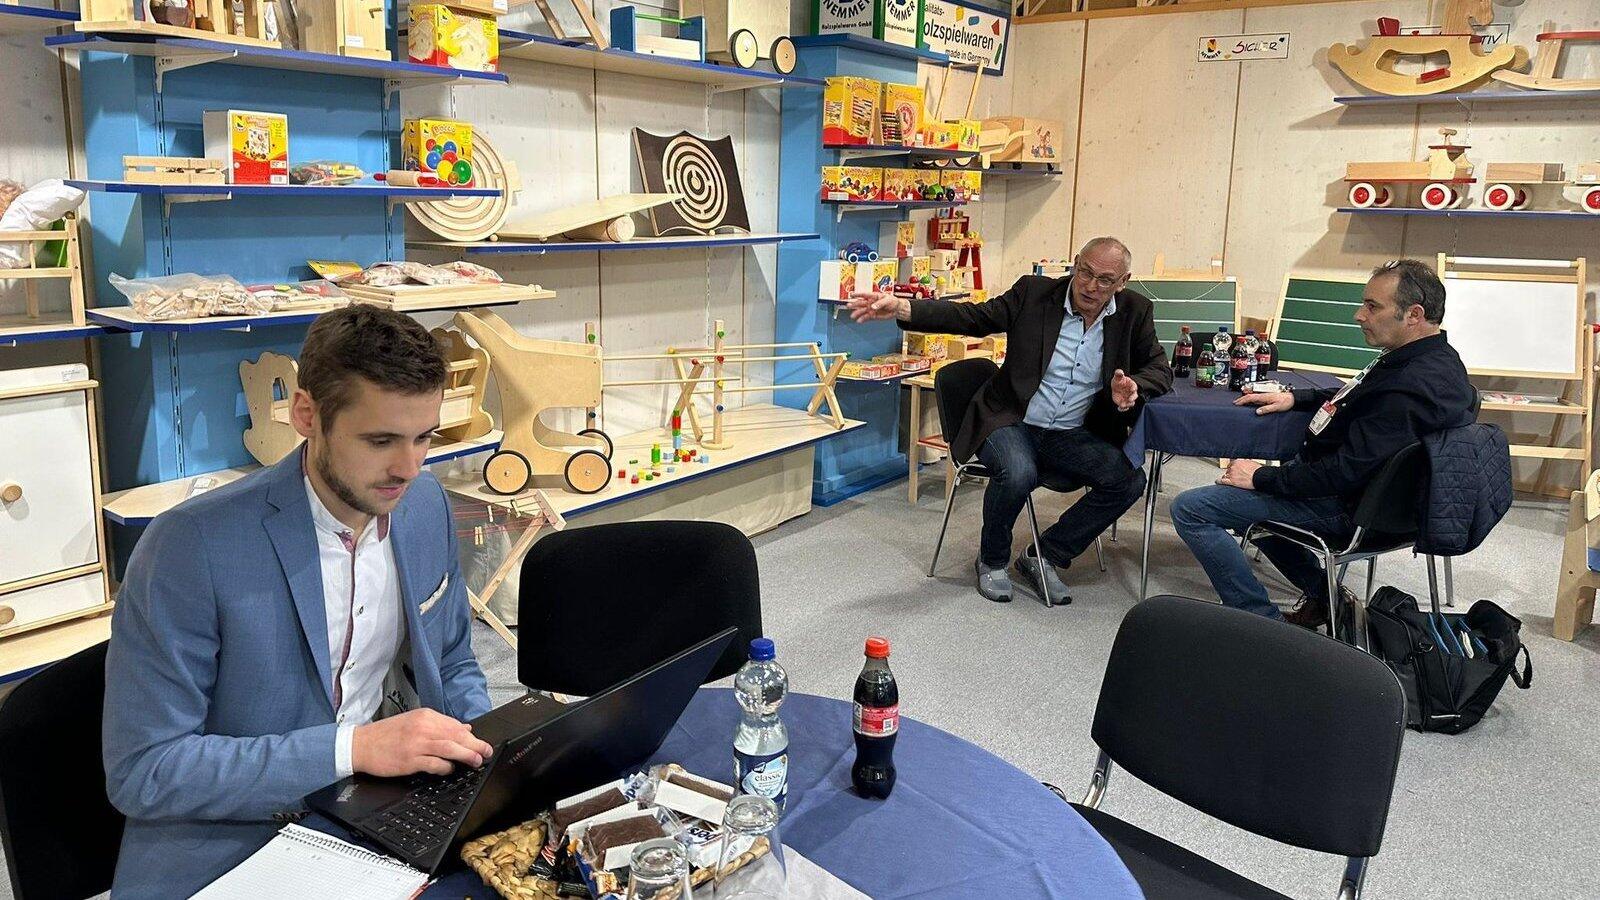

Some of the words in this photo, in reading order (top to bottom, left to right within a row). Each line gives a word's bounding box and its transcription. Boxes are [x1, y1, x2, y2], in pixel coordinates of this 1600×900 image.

[923, 18, 994, 51] olzspielwaren
[1480, 32, 1503, 45] TIV
[967, 51, 990, 67] Germny
[754, 770, 782, 782] classic
